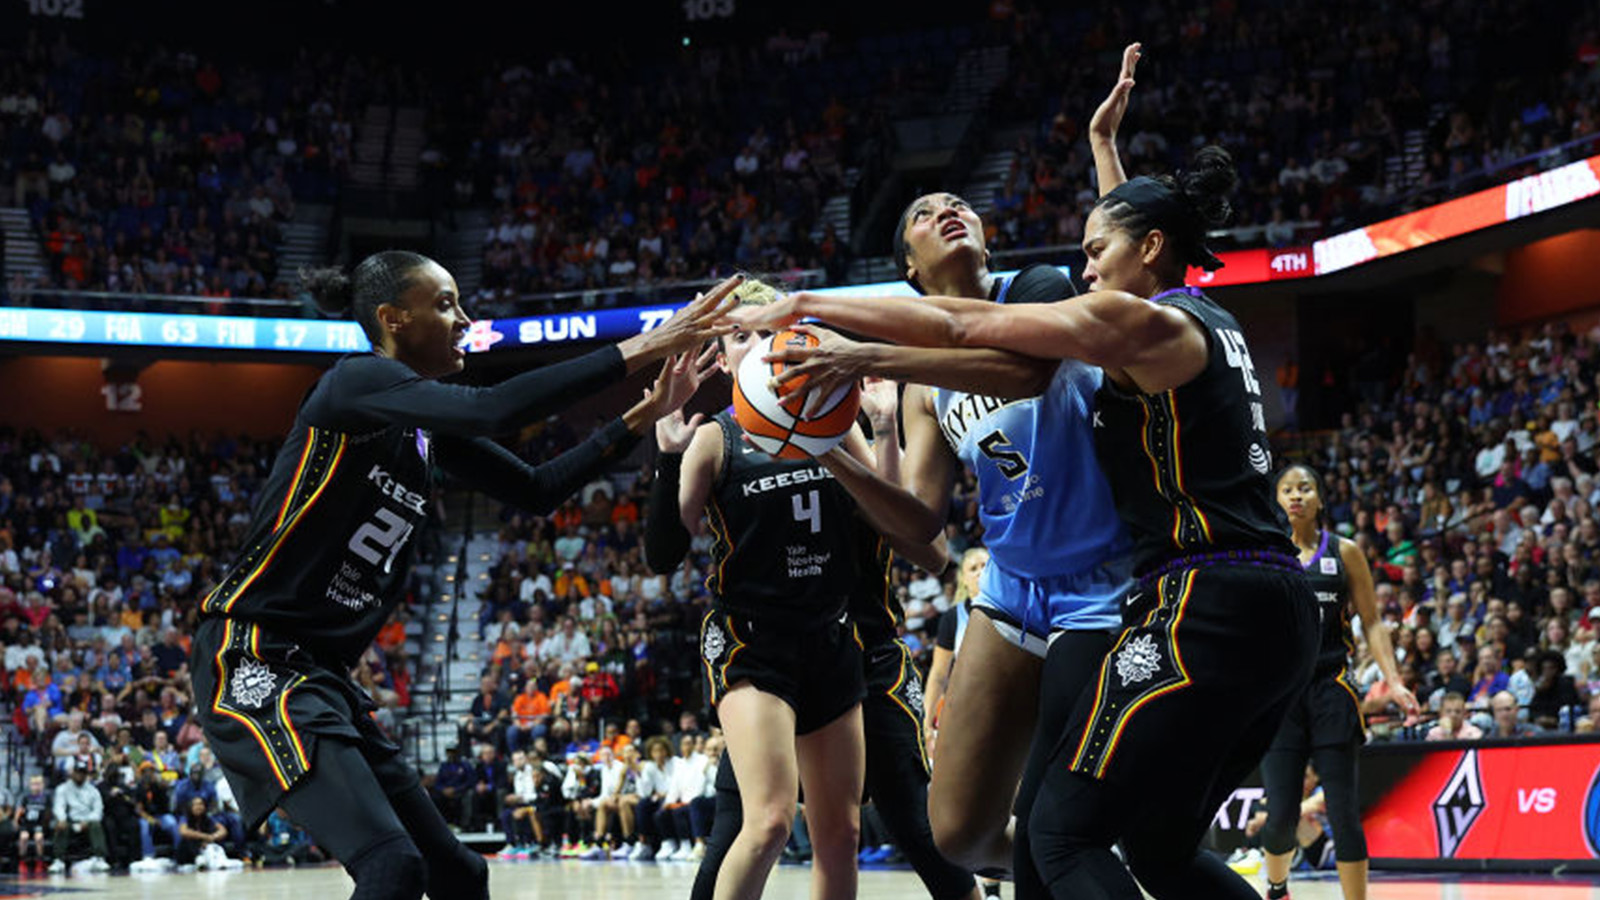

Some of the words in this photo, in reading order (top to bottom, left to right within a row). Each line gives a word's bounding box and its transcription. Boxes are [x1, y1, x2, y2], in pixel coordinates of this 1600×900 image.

[1270, 253, 1308, 272] 4TH
[49, 315, 86, 339] 29
[162, 320, 198, 343] 63
[273, 322, 308, 347] 17
[519, 315, 597, 344] SUN
[101, 384, 142, 410] 12
[977, 430, 1029, 481] 5
[792, 490, 821, 533] 4
[787, 565, 822, 578] Health
[1517, 788, 1556, 813] VS
